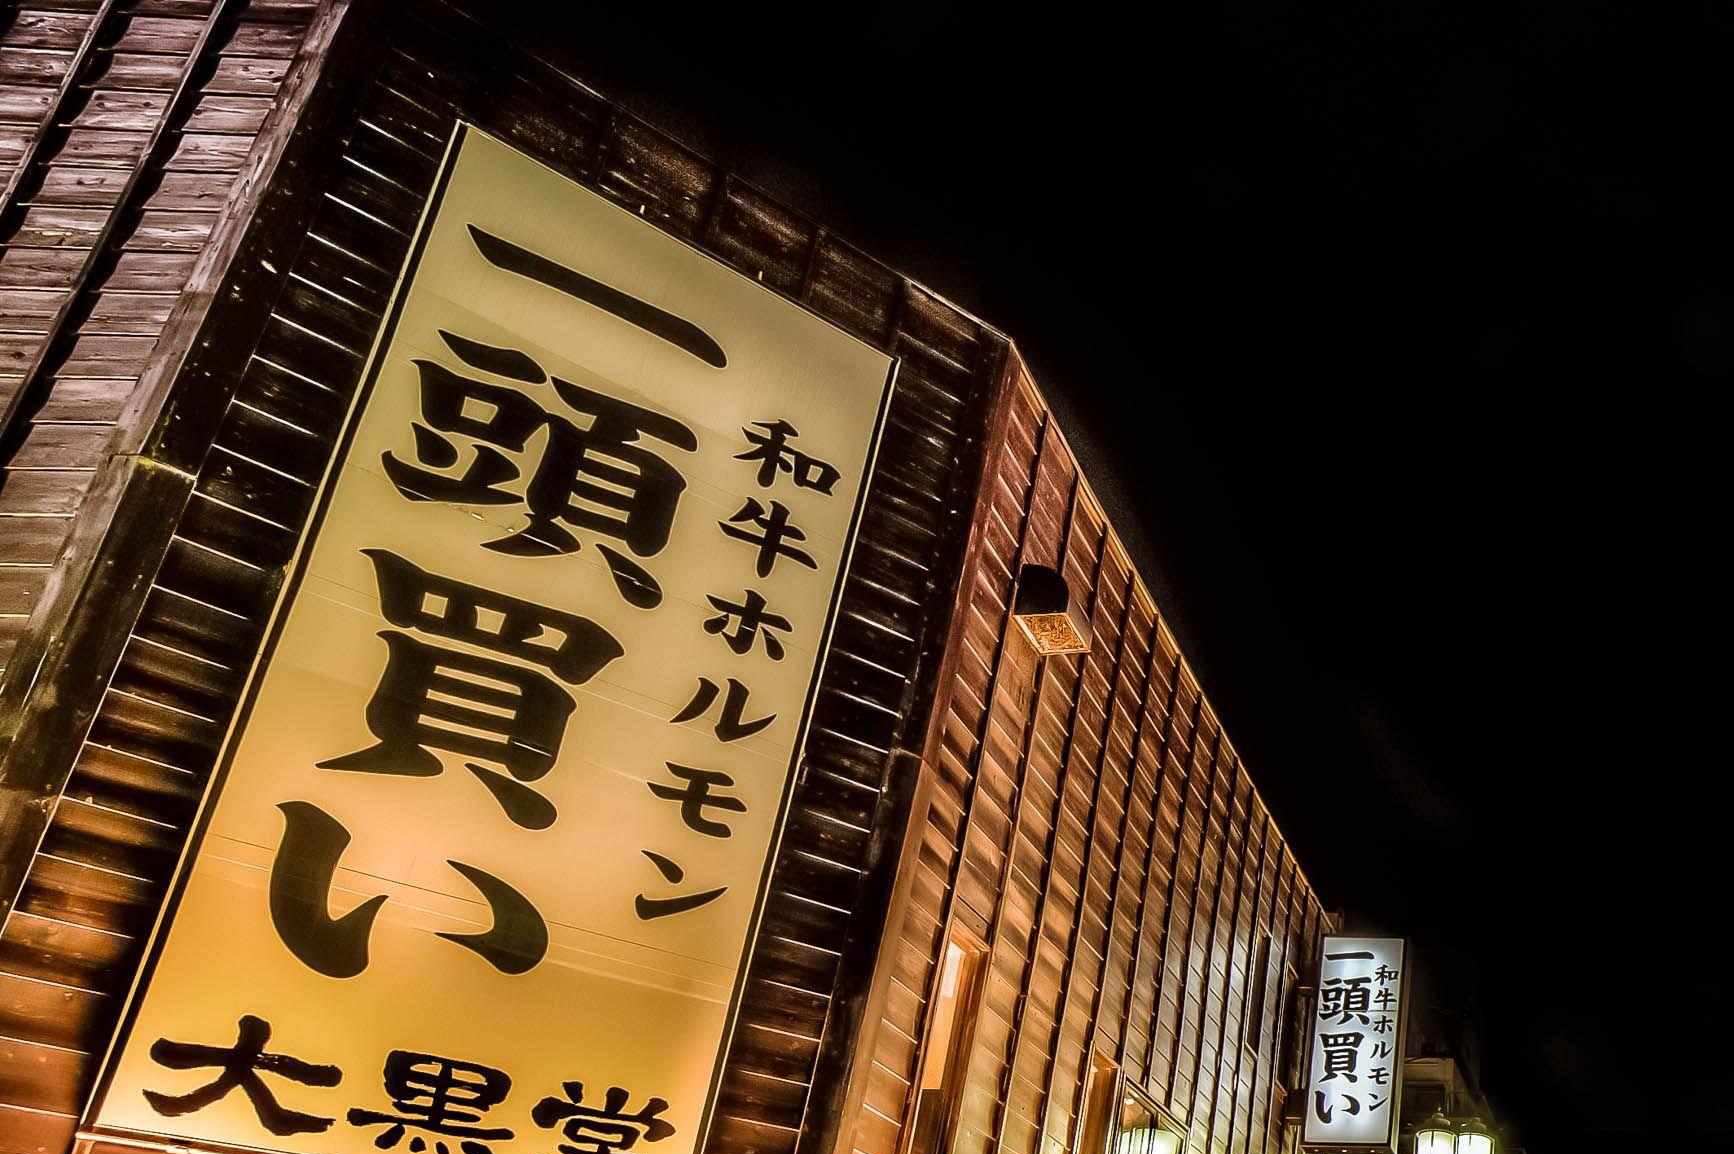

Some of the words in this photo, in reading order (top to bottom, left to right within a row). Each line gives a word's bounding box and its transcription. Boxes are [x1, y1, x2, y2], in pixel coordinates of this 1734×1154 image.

[269, 222, 728, 980] 一頭買い
[634, 417, 843, 921] 和牛ホルモン
[1315, 949, 1375, 1125] 一頭買い
[1369, 963, 1399, 1113] 和牛ホルモン
